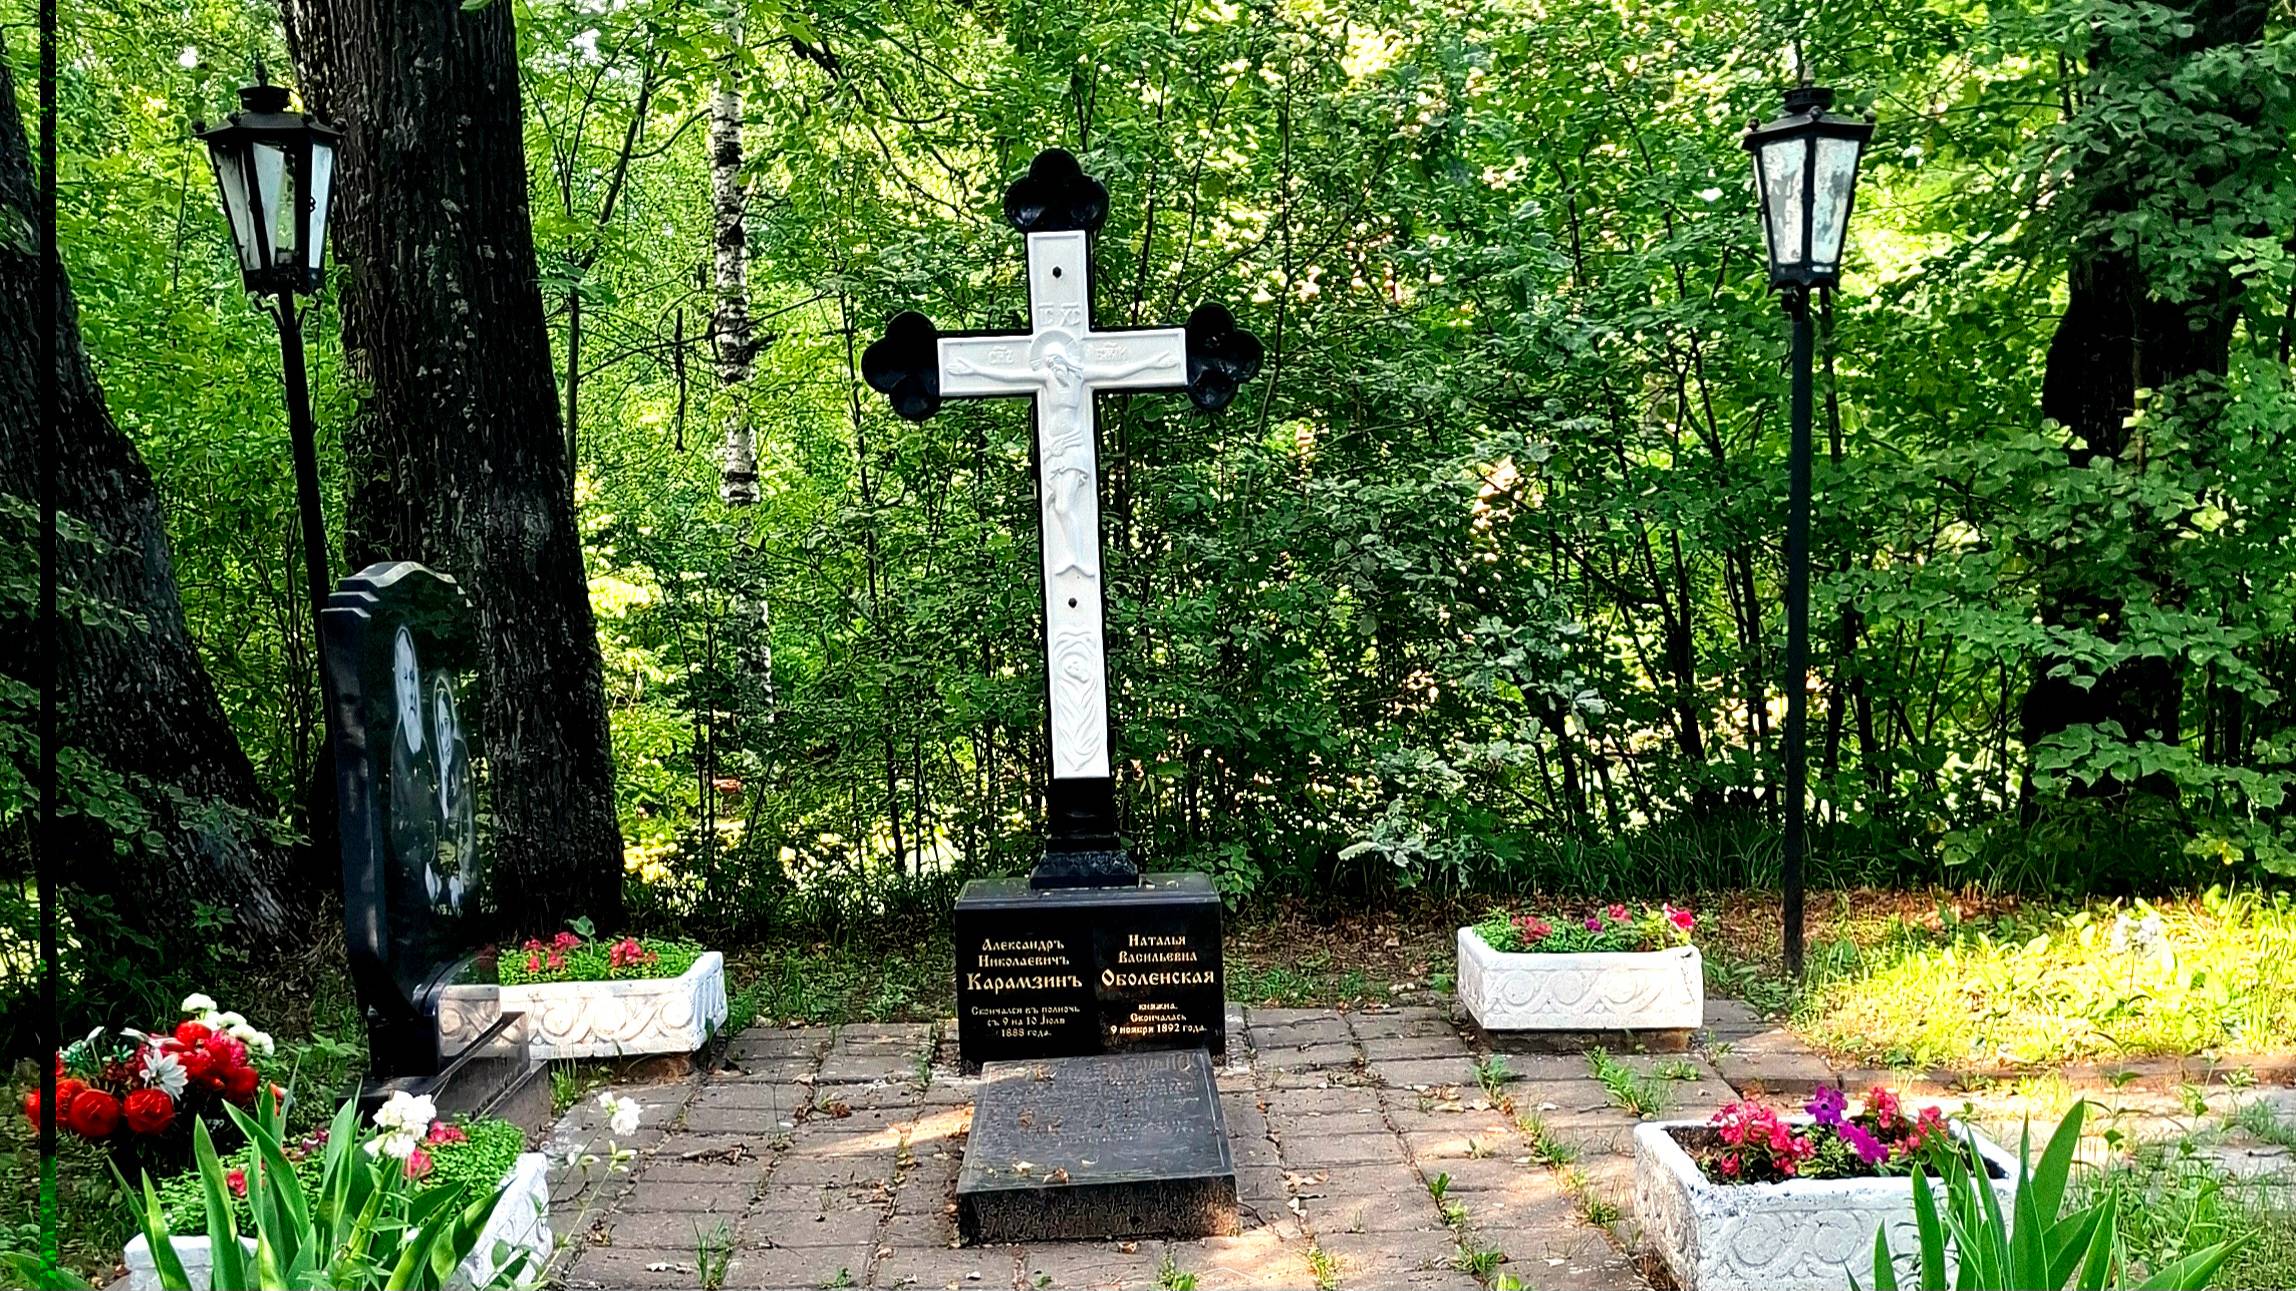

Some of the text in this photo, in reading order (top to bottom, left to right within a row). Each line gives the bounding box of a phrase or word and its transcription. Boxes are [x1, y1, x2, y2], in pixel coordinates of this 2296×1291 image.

[982, 938, 1065, 952] Александръ
[1128, 934, 1186, 947] Наталья
[978, 954, 1070, 968] Николаевичъ
[1118, 950, 1198, 964] Васильевна
[966, 972, 1083, 995] Карамзинъ
[1101, 968, 1215, 987] Оболенская
[1002, 1016, 1009, 1026] 9
[1110, 1024, 1118, 1034] 9
[1156, 1022, 1180, 1033] 1892
[1001, 1027, 1025, 1038] 1888
